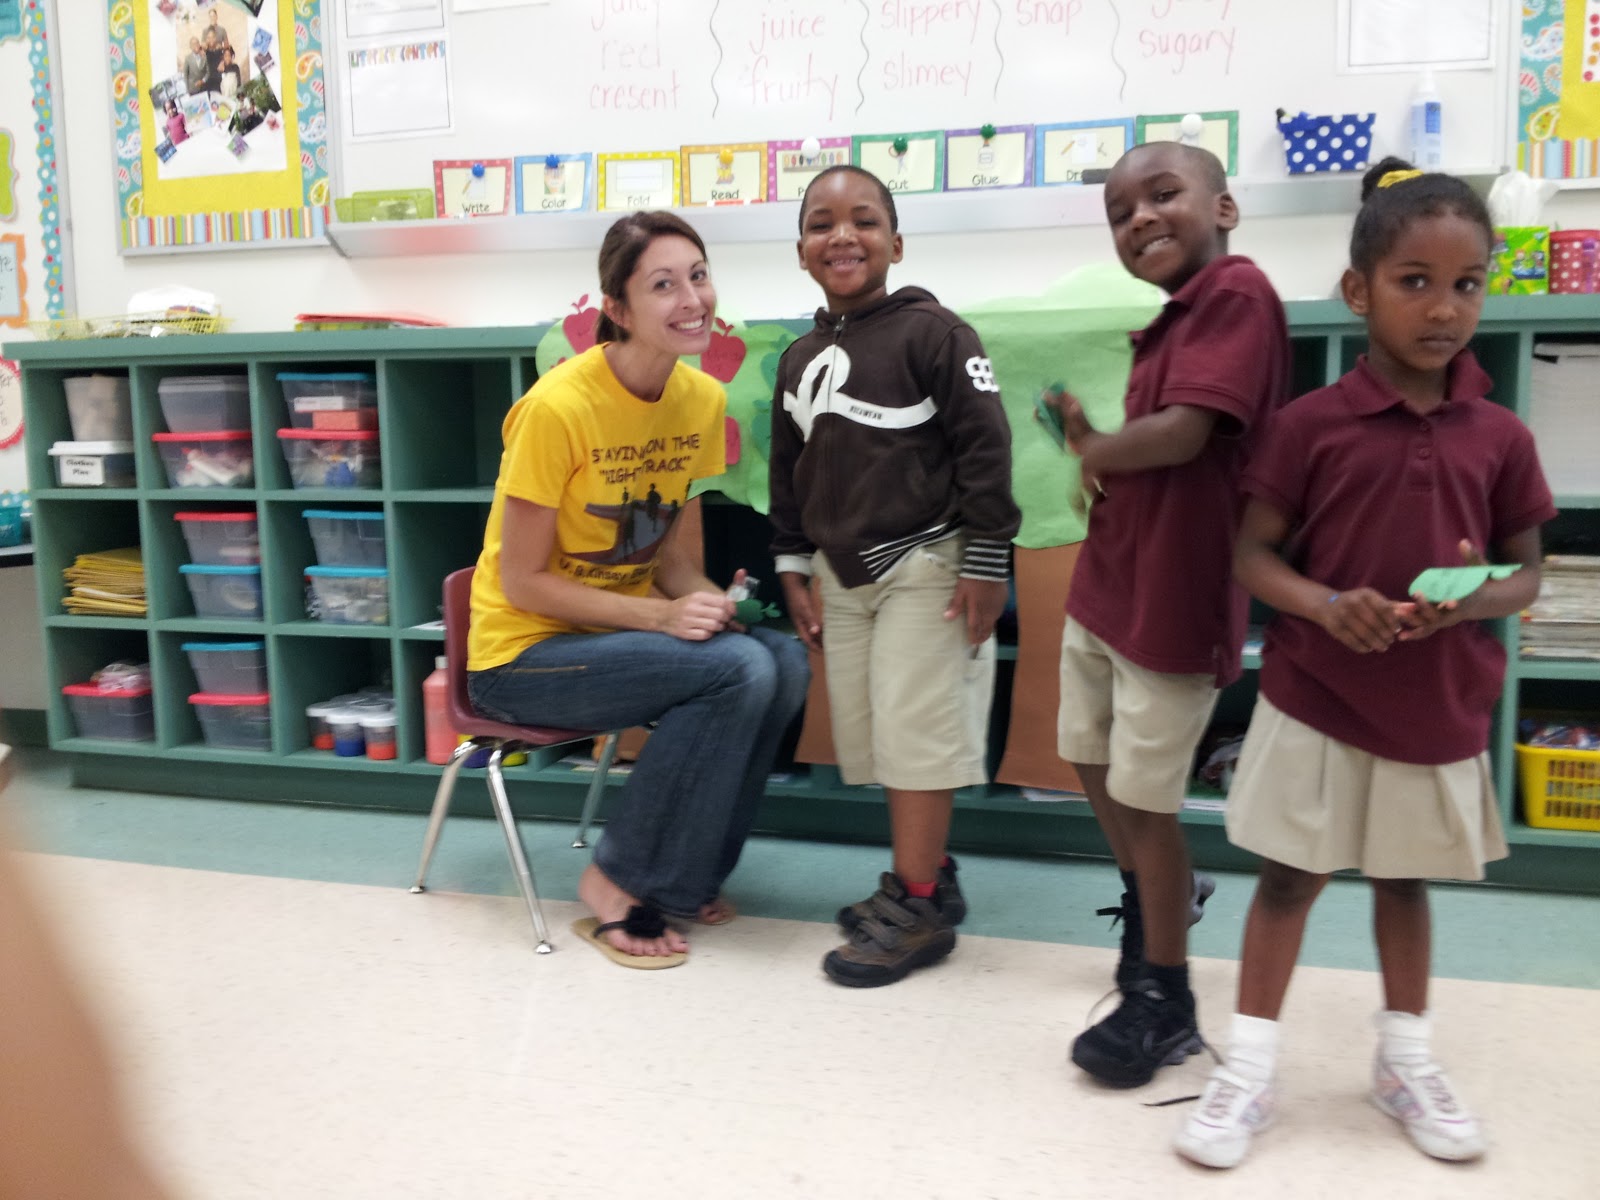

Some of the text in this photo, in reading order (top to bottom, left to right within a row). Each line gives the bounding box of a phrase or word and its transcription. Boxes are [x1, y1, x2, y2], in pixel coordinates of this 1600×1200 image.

[749, 10, 826, 55] juice
[601, 39, 661, 71] red
[1138, 26, 1236, 75] sugary
[883, 50, 972, 96] slimey
[590, 69, 680, 110] cresent
[739, 51, 839, 121] fruity
[887, 179, 908, 192] Cut
[971, 174, 1000, 187] Glue
[541, 198, 567, 210] Color
[627, 195, 651, 207] Fold
[710, 189, 740, 201] Read
[462, 202, 490, 213] Write
[646, 438, 666, 454] ON
[672, 433, 700, 450] THE
